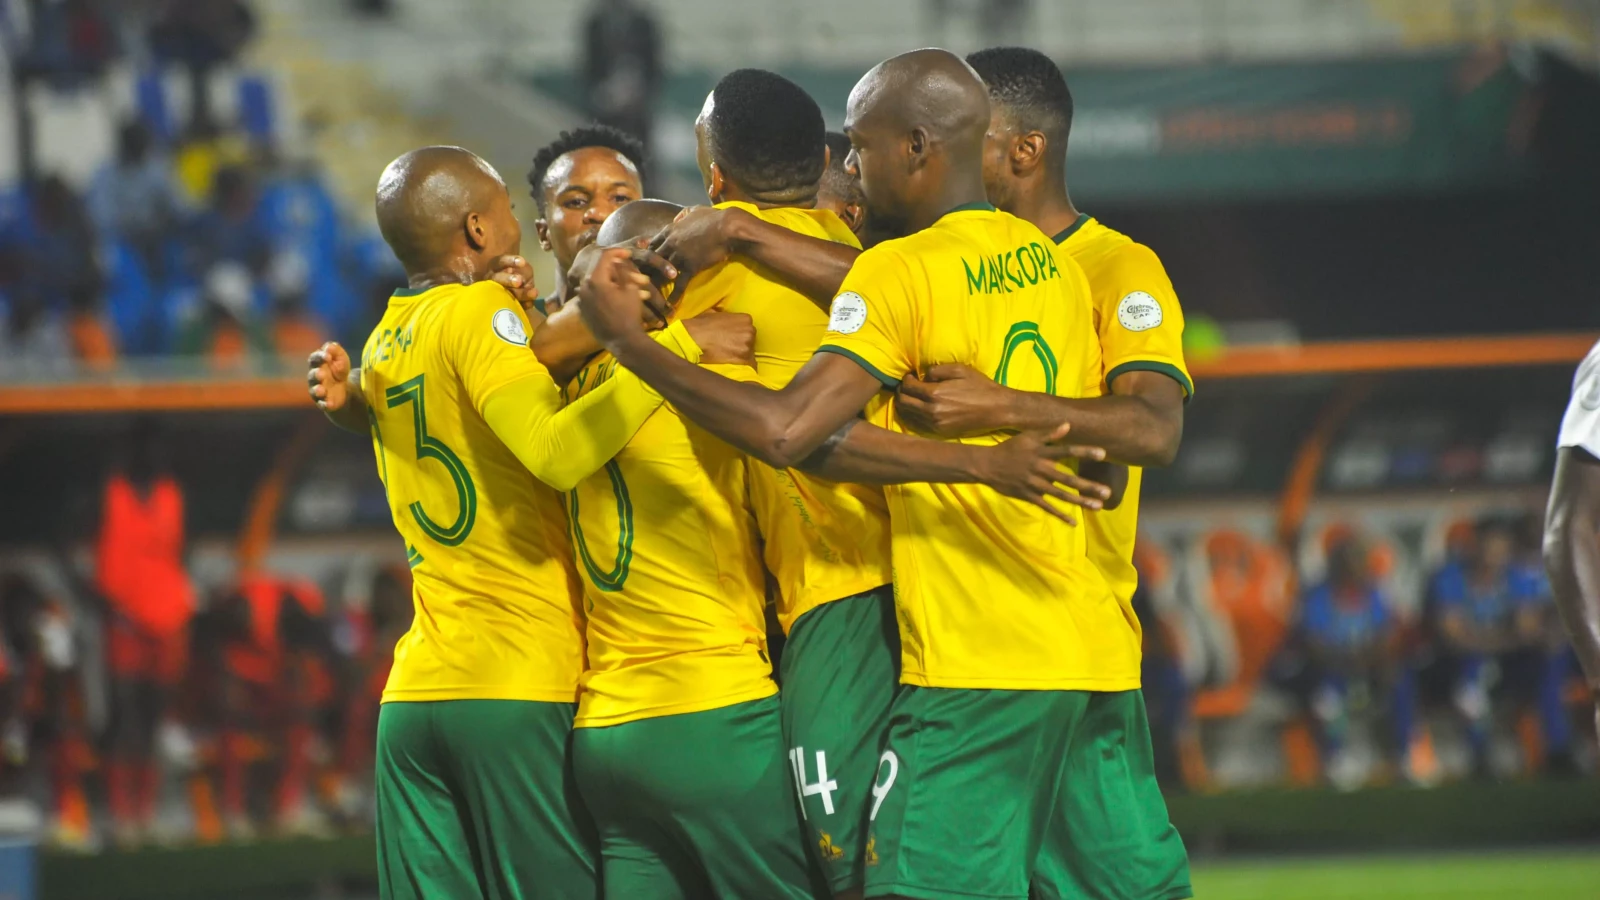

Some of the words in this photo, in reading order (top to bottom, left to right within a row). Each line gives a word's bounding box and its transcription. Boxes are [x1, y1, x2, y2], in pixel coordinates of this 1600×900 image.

[960, 241, 1061, 295] MAKGOPA
[369, 373, 477, 568] 3
[789, 747, 838, 820] 14
[870, 750, 898, 821] 9
